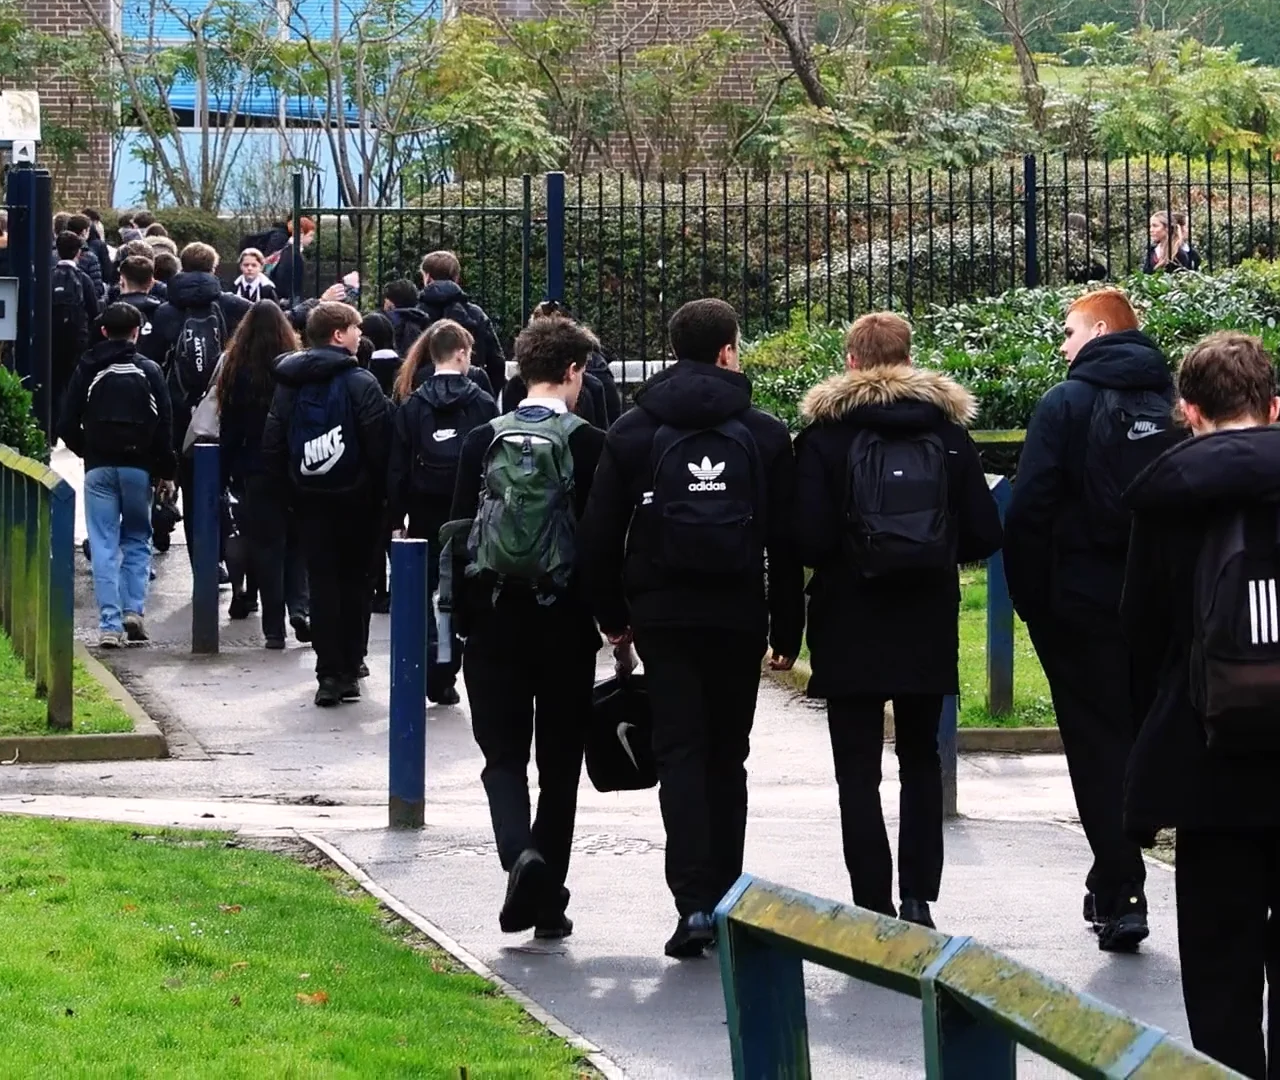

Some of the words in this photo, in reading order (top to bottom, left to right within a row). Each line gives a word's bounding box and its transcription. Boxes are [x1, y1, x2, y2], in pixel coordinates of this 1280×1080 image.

[1133, 420, 1158, 432] NIKE
[304, 425, 343, 467] NIKE
[688, 480, 727, 492] adidas
